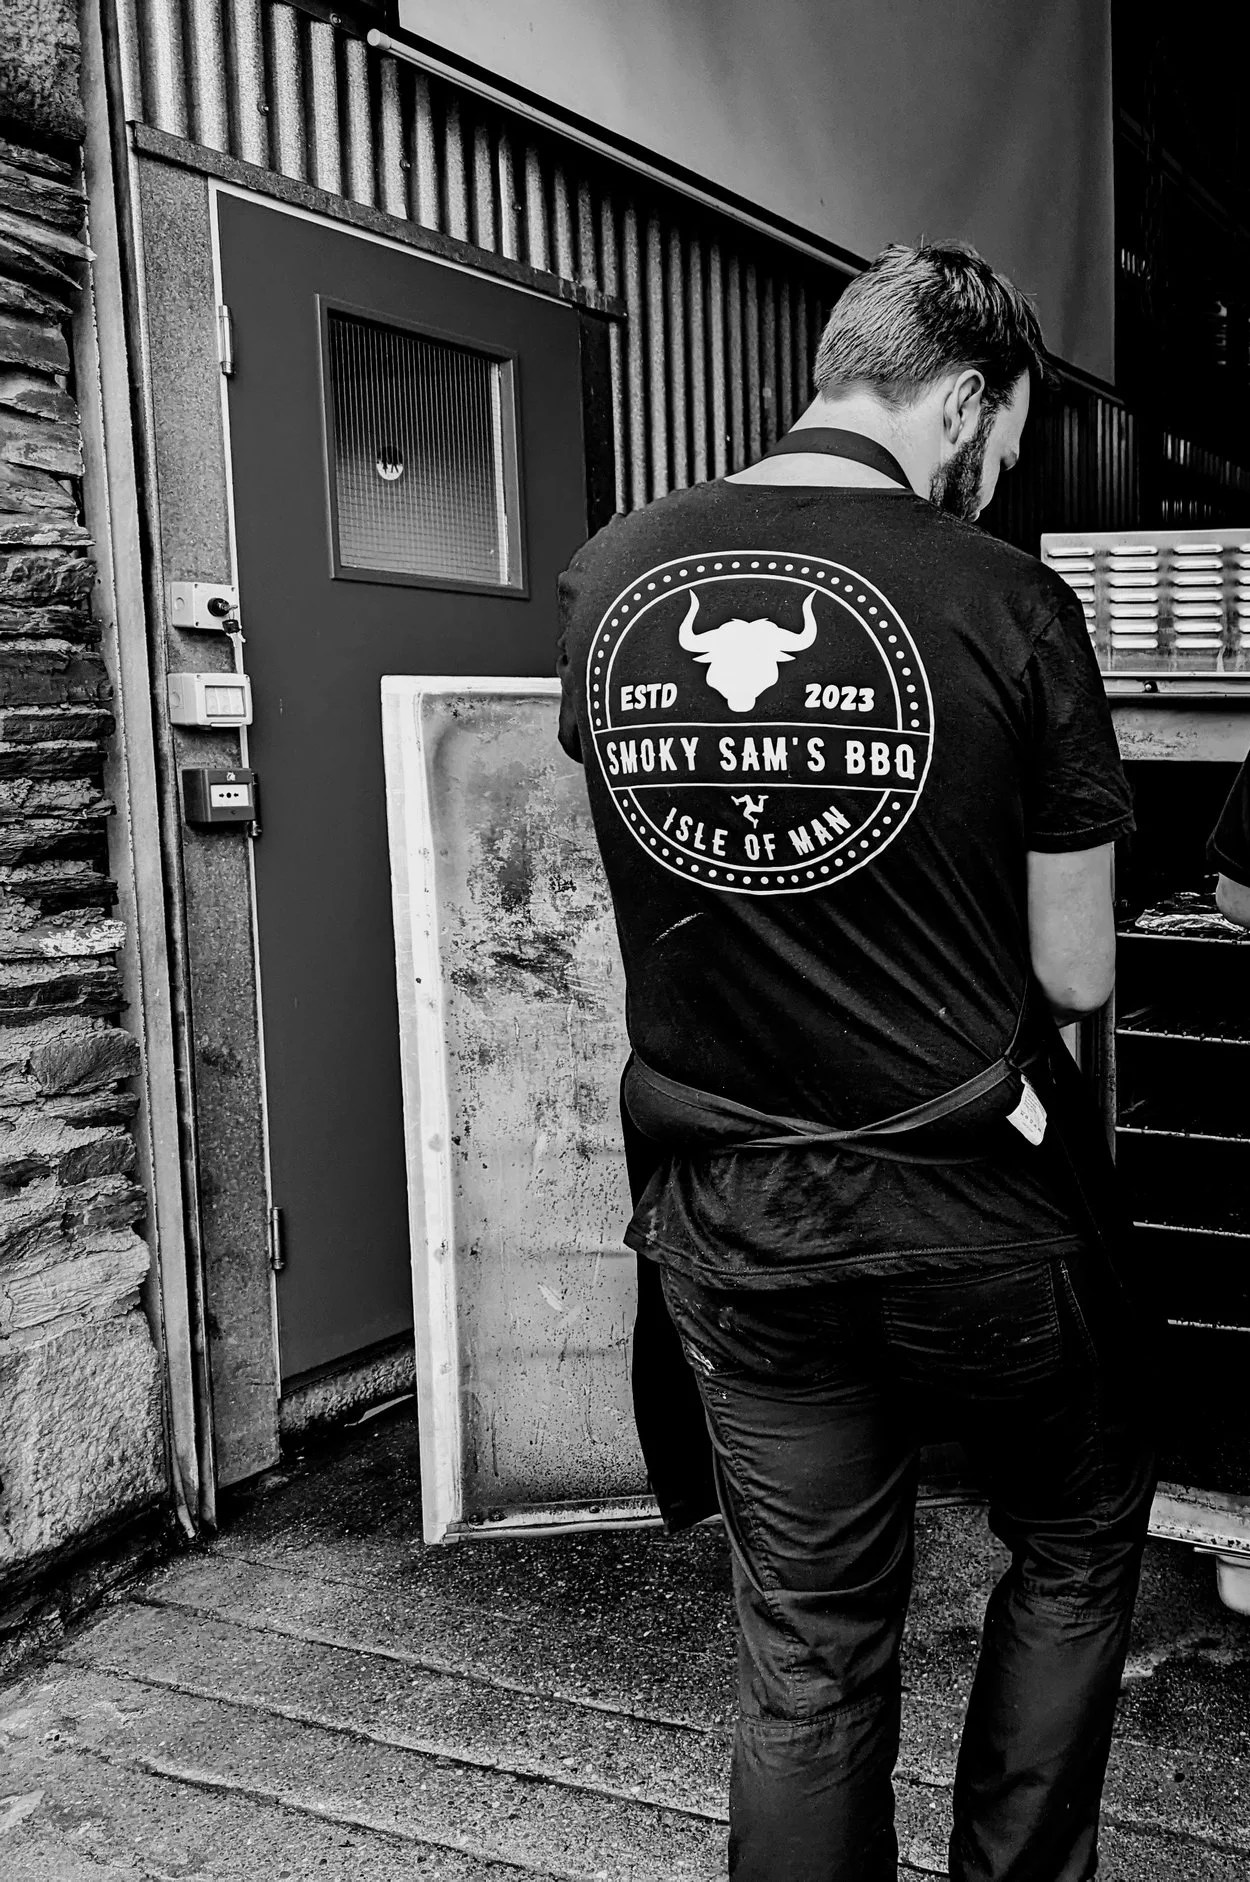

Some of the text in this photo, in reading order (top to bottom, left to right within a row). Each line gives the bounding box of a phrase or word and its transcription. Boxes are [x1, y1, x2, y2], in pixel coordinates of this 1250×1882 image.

[620, 682, 875, 713] ESTD 2023
[606, 736, 917, 780] SMOKY SAM'S BBQ
[662, 805, 852, 861] ISLE OF MAN
